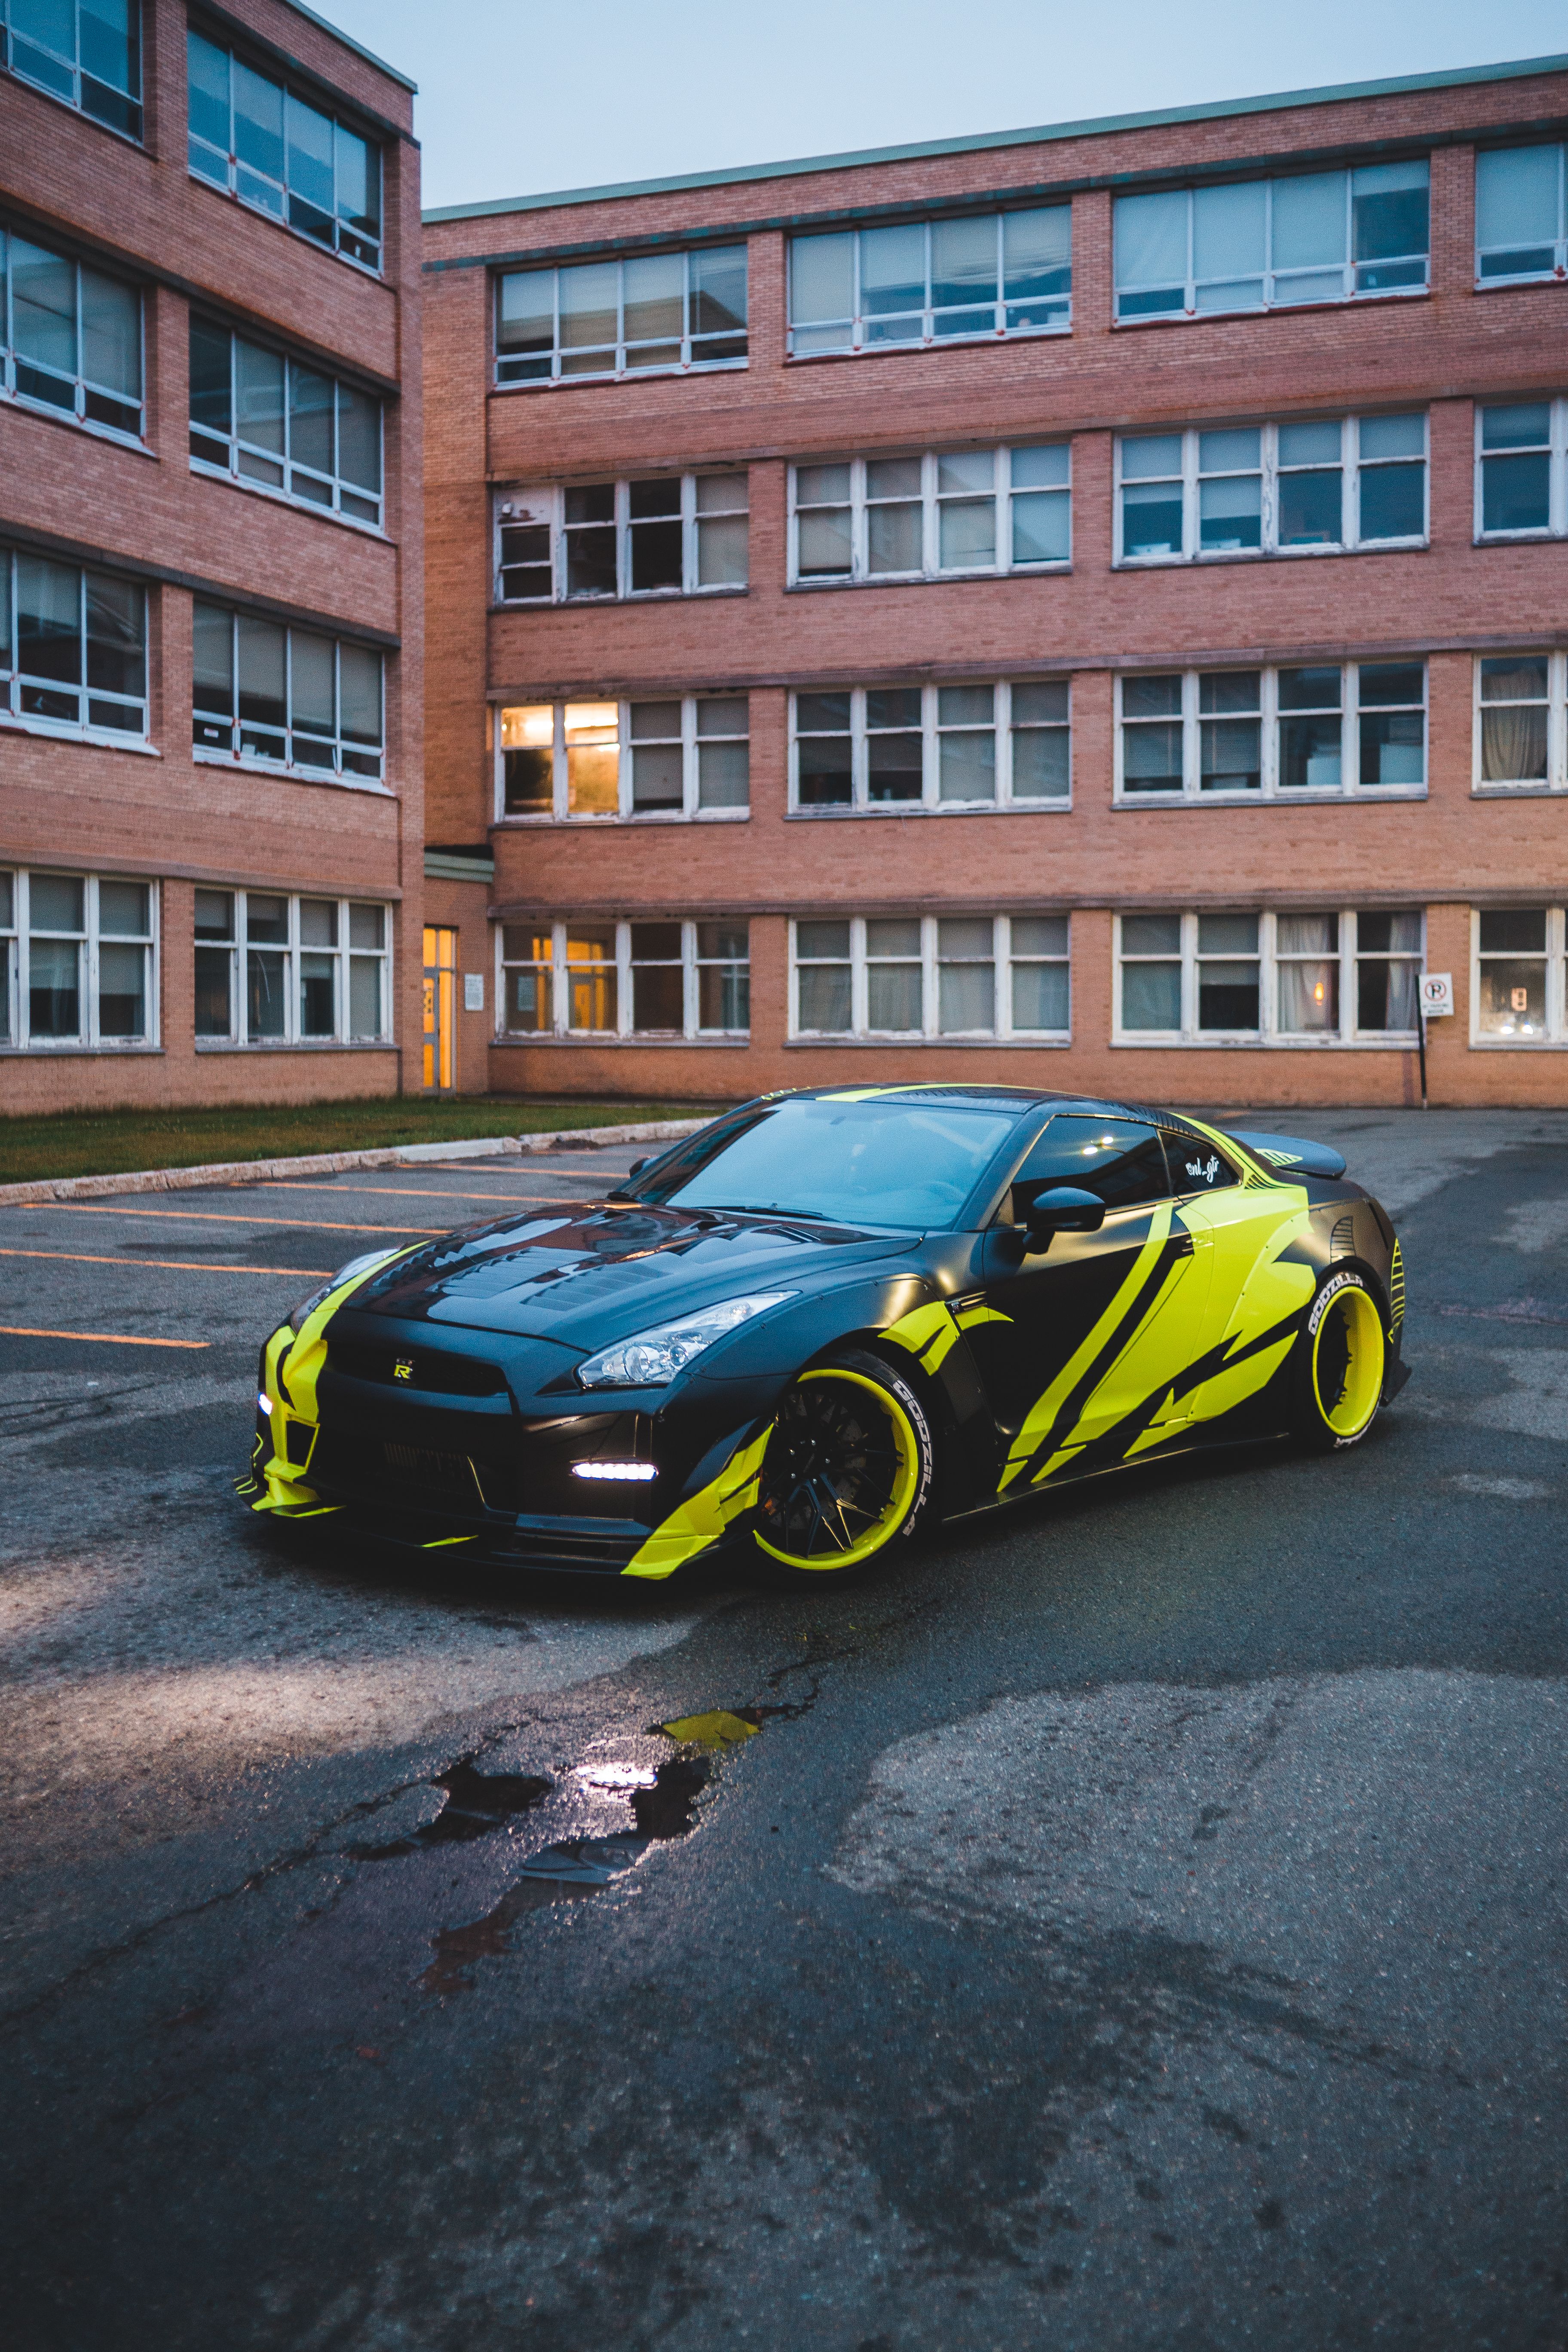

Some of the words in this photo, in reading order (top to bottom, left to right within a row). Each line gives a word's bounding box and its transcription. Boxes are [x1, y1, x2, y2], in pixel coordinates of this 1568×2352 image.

[1431, 983, 1441, 998] P
[1308, 1271, 1363, 1335] GODZILLA
[893, 1380, 932, 1536] GODZILLA
